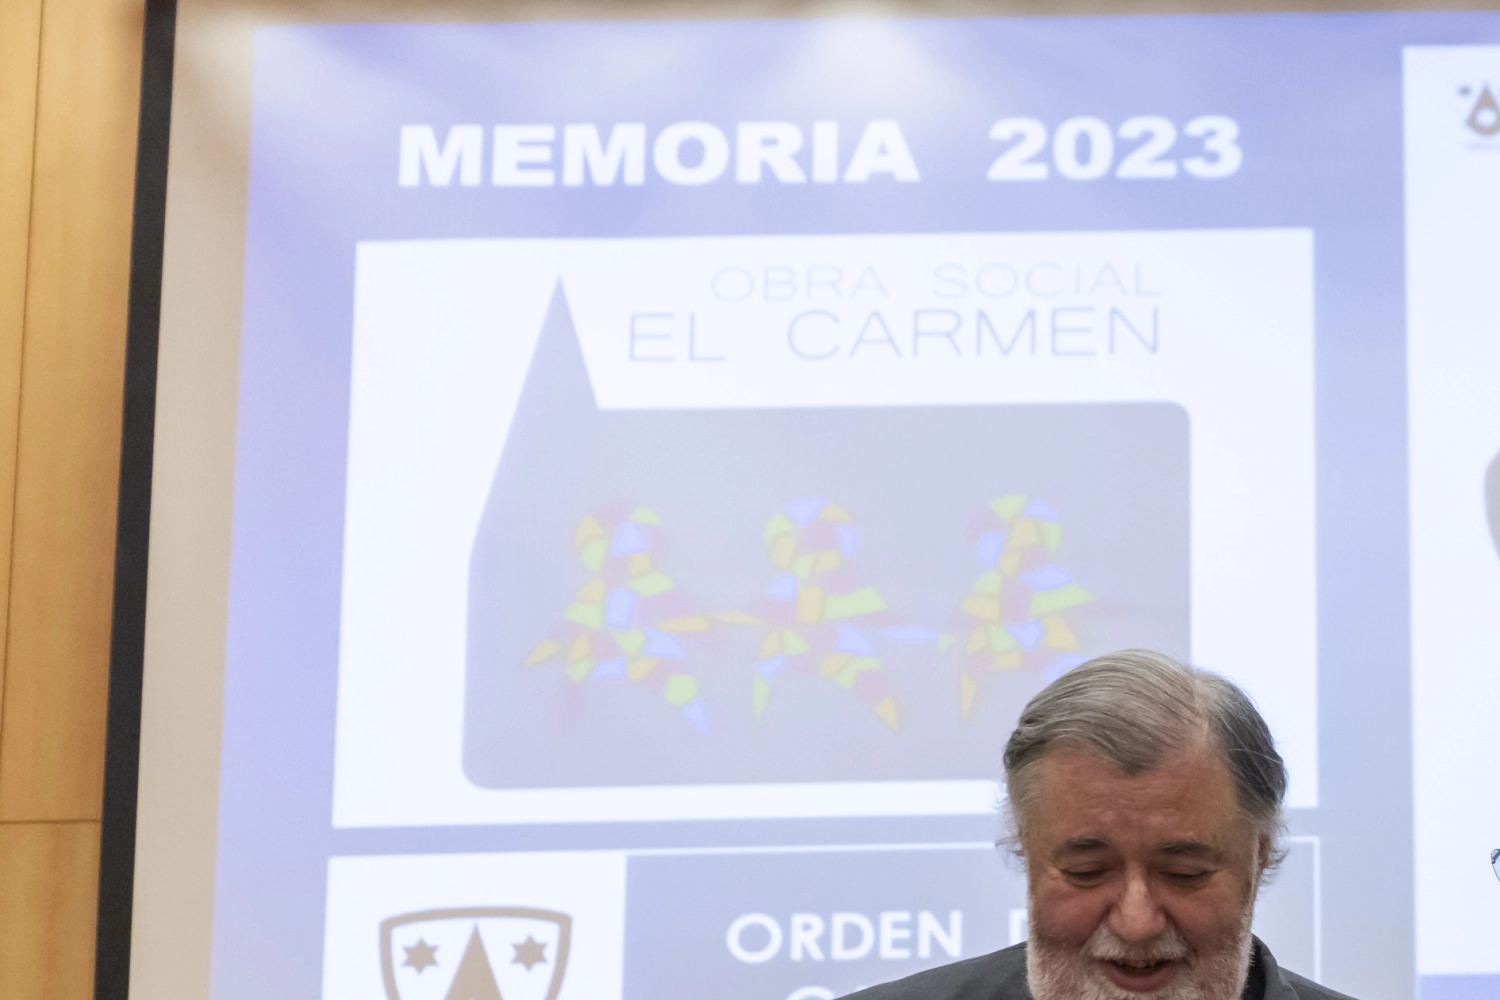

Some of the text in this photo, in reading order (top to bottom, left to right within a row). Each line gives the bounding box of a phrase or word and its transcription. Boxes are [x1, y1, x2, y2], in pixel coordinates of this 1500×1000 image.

[399, 115, 1243, 187] MEMORIA 2023
[711, 262, 1163, 302] OBRA SOCIAL
[628, 306, 1159, 362] EL CARMEN
[726, 909, 963, 964] ORDEN
